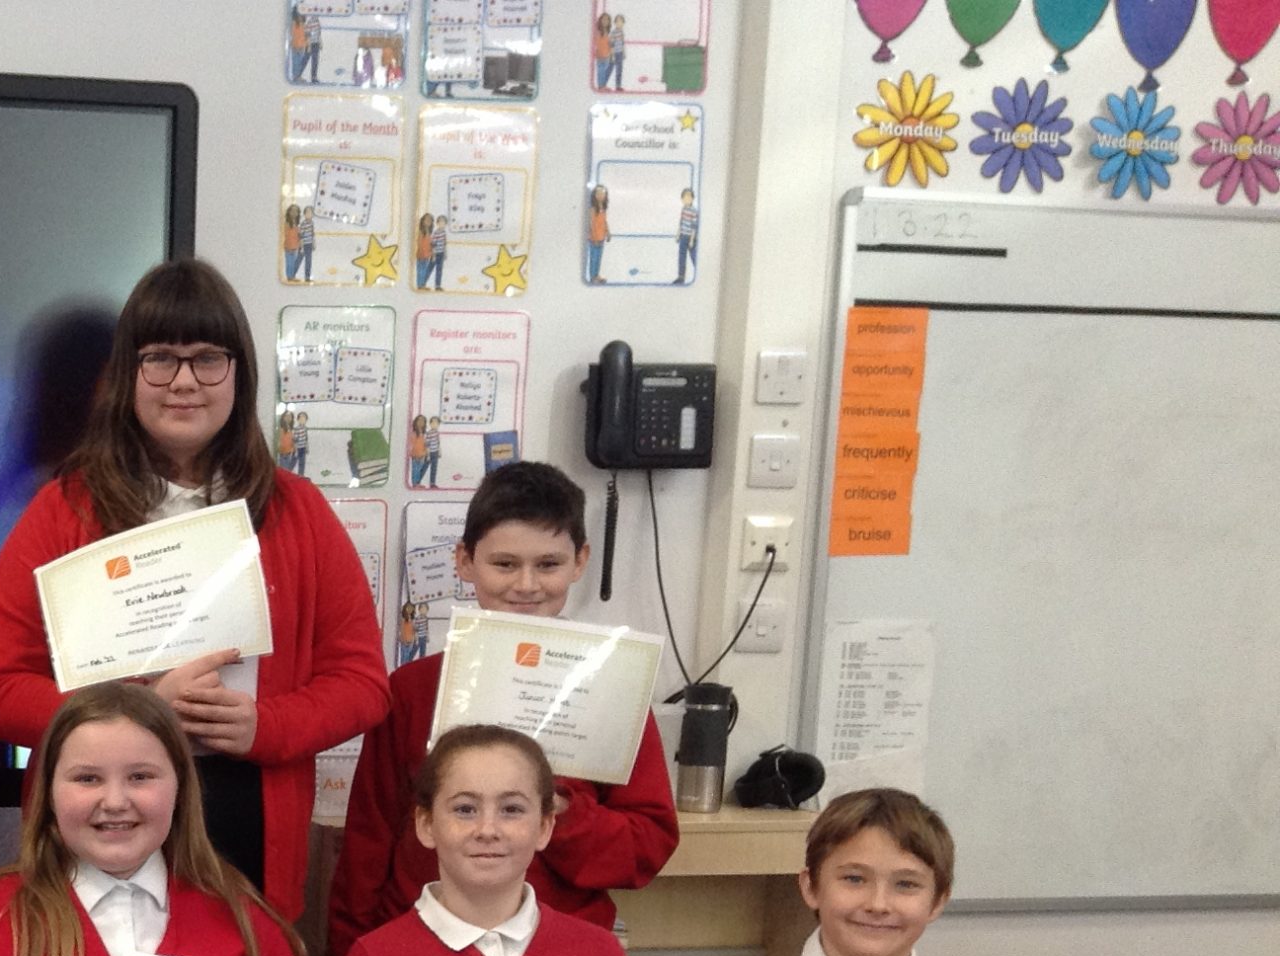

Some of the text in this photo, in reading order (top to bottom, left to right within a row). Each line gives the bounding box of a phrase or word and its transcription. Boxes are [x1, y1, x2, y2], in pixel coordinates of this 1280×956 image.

[292, 120, 399, 136] Pupil of the Month
[642, 123, 674, 134] School
[878, 120, 945, 140] Monday
[615, 139, 664, 149] Councillor
[992, 127, 1061, 148] Tuesday
[1097, 133, 1181, 154] Wednesday
[1208, 137, 1280, 157] Thursday
[304, 321, 371, 332] AR monitors
[857, 322, 916, 334] profession
[430, 328, 518, 341] Register monitors
[852, 364, 914, 379] opportunity
[842, 406, 910, 418] mischievous
[843, 444, 913, 461] frequently
[844, 487, 897, 500] criticise
[848, 528, 891, 541] bruise
[133, 542, 182, 562] Accelerated
[324, 776, 347, 791] Ask
